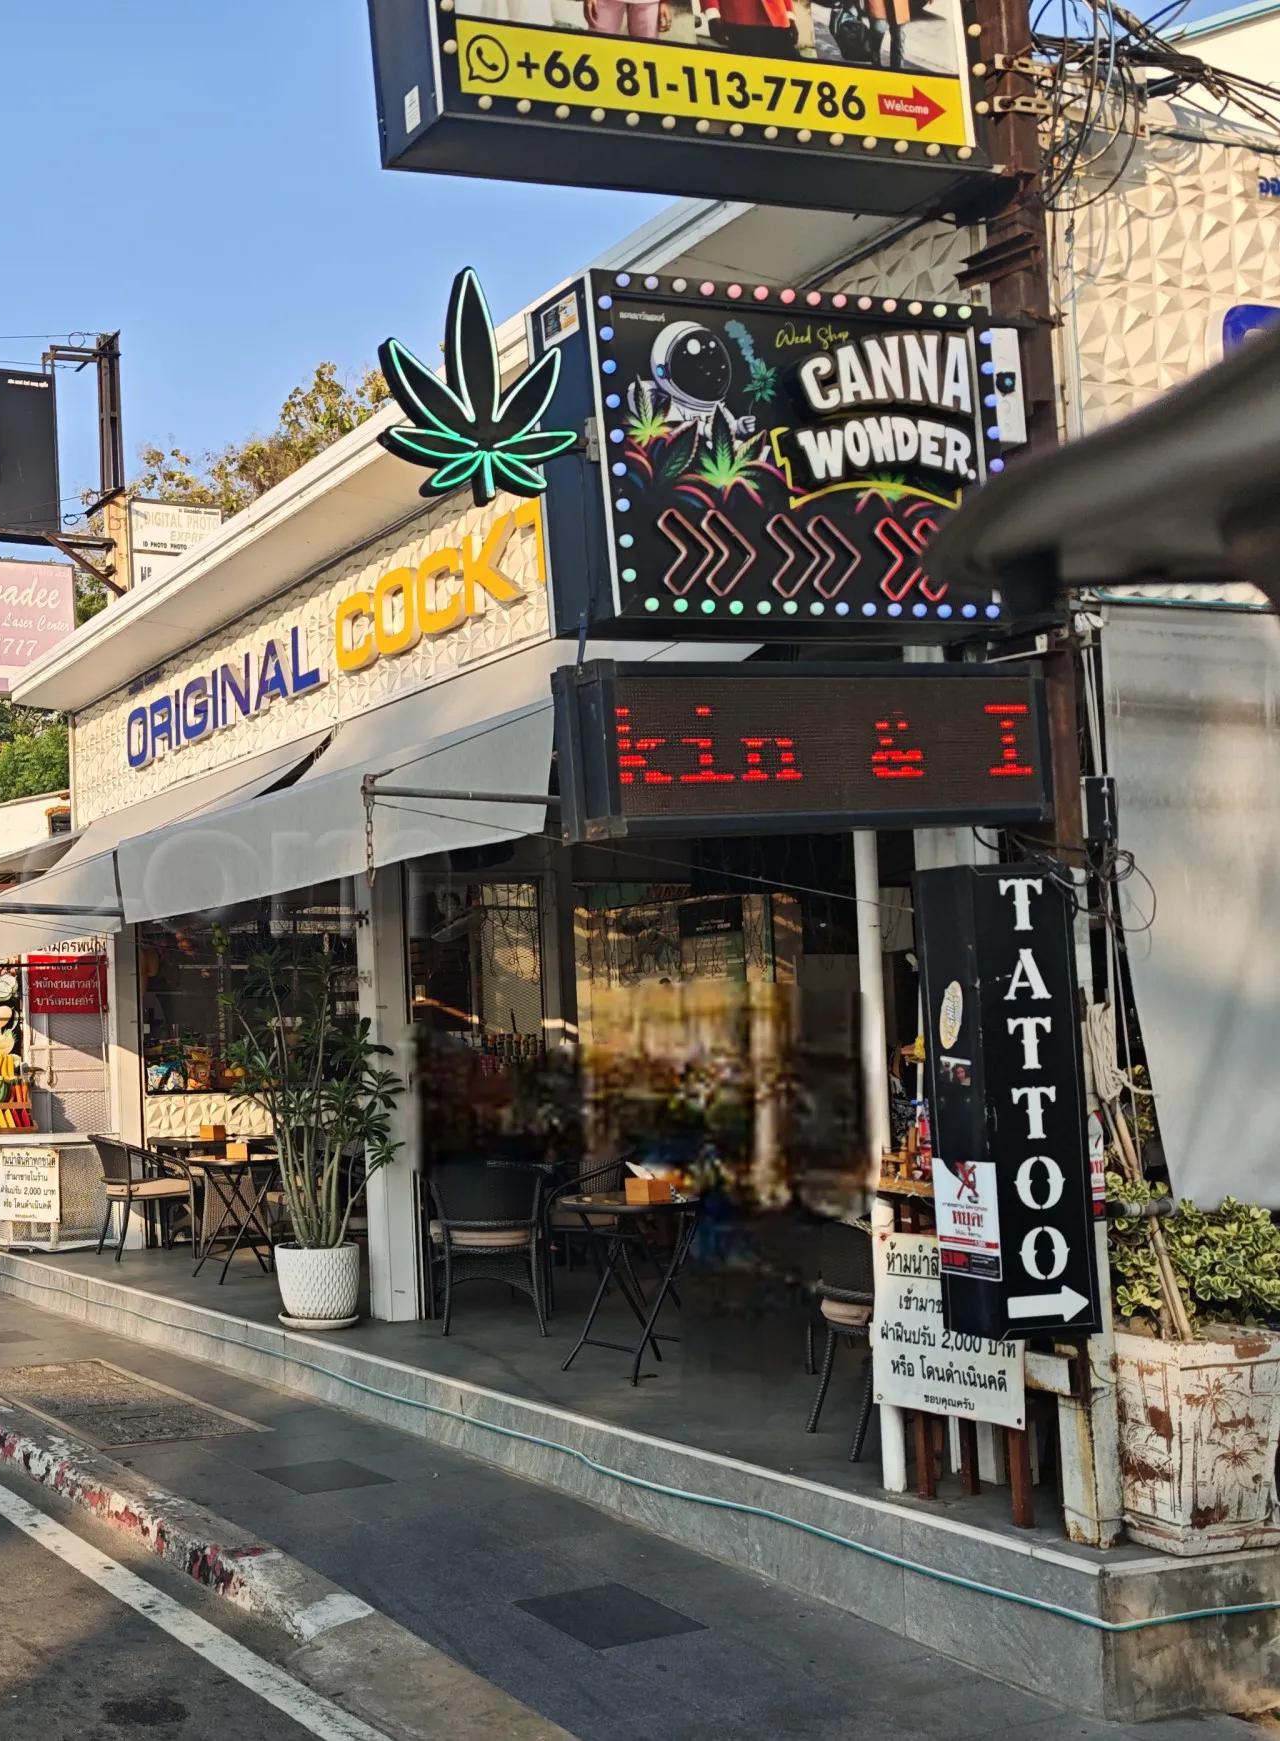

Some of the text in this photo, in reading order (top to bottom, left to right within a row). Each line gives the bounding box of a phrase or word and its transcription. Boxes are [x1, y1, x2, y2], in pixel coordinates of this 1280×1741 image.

[516, 50, 867, 121] +66 81-113-7786
[883, 98, 930, 117] Welcome
[775, 321, 850, 351] Weed Shop
[799, 331, 974, 415] CANNA
[150, 541, 168, 549] PHOTO
[1, 613, 34, 630] Laser
[36, 615, 71, 633] Center
[126, 624, 325, 768] ORIGINAL
[997, 877, 1072, 1281] TATTOO
[951, 1209, 984, 1232] หยุด!
[880, 1320, 1017, 1359] ฝ่าฝืนปรับ 2,000 บาท
[891, 1354, 1008, 1392] หรือ โดนดำเนินคดี
[923, 1392, 975, 1411] ขอบคุณครับ
